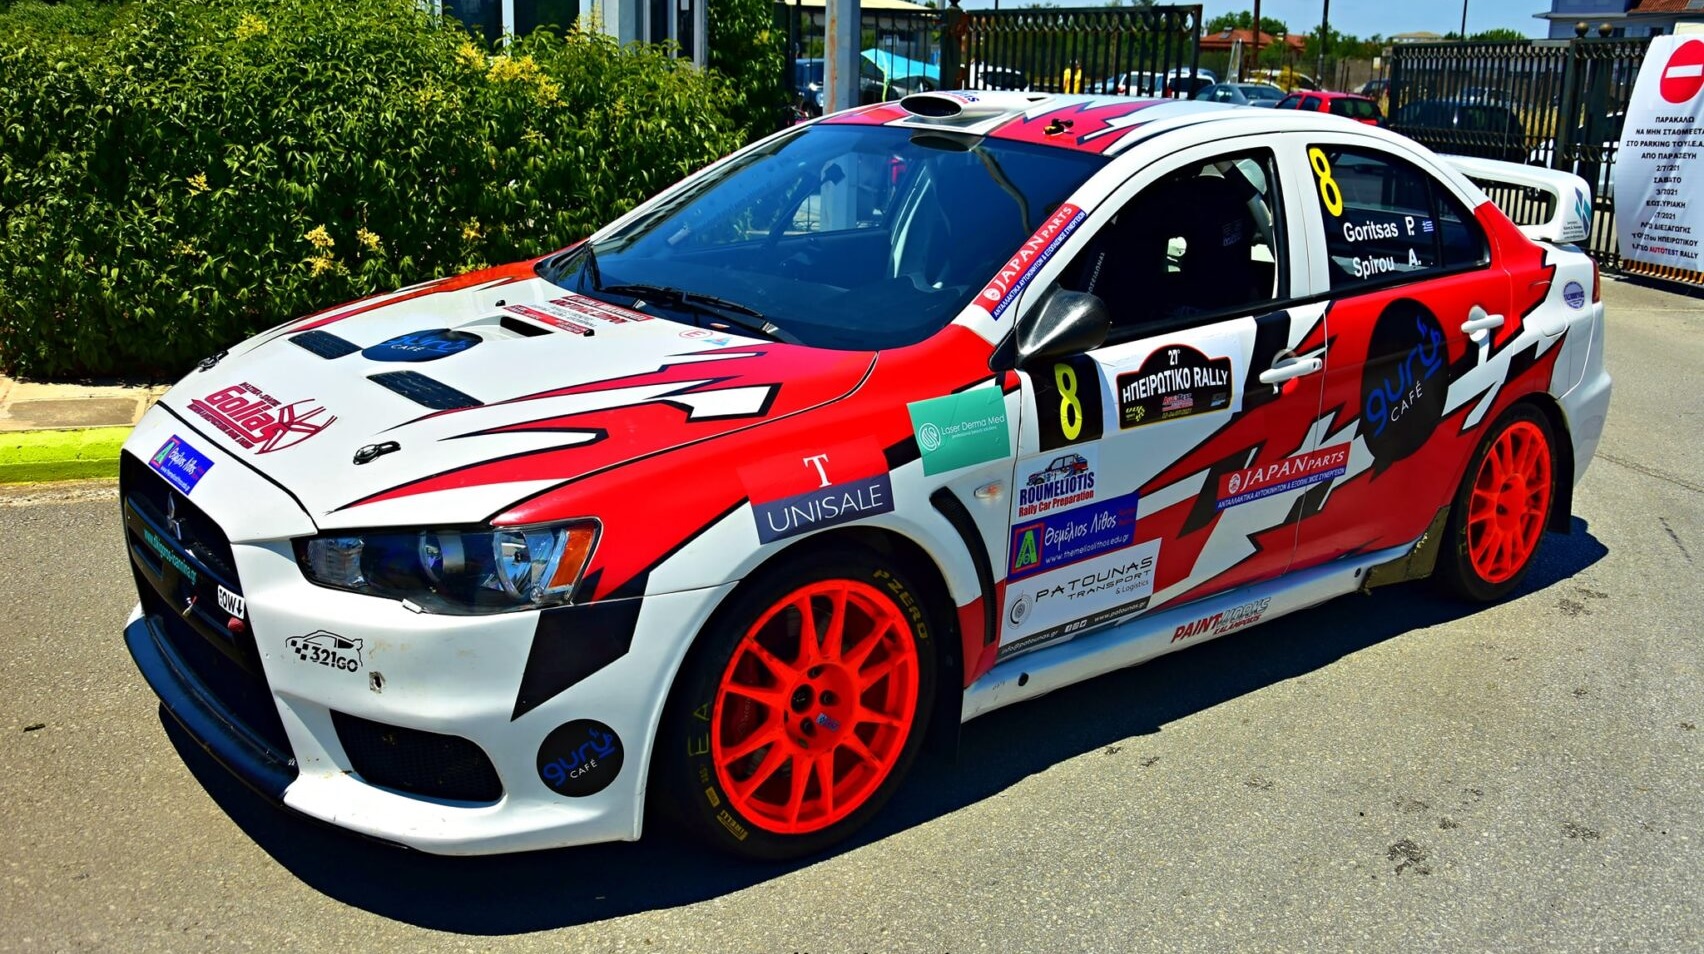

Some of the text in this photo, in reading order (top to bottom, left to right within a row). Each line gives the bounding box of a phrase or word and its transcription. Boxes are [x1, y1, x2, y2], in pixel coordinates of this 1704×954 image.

[1640, 140, 1670, 148] PARKING
[1641, 152, 1657, 160] ΑΠΟ
[1308, 147, 1343, 217] 8
[1343, 216, 1416, 242] Goritsas P.
[1352, 248, 1421, 280] Spirou A.
[1679, 250, 1699, 259] RALLY
[1122, 366, 1191, 404] ΗΠΕΙΡΩΤΙΚΟ
[1194, 369, 1228, 389] RALLY
[1054, 362, 1083, 440] 8
[941, 414, 1005, 435] Laser Derma Med
[803, 454, 832, 488] T
[1018, 490, 1094, 518] Rally Car Preparation
[1019, 471, 1095, 506] ROUMELIOTIS
[767, 485, 884, 533] UNISALE
[1035, 556, 1153, 603] PATOUNAS
[1067, 569, 1152, 600] TRANSPORT
[1121, 579, 1149, 594] Logistics
